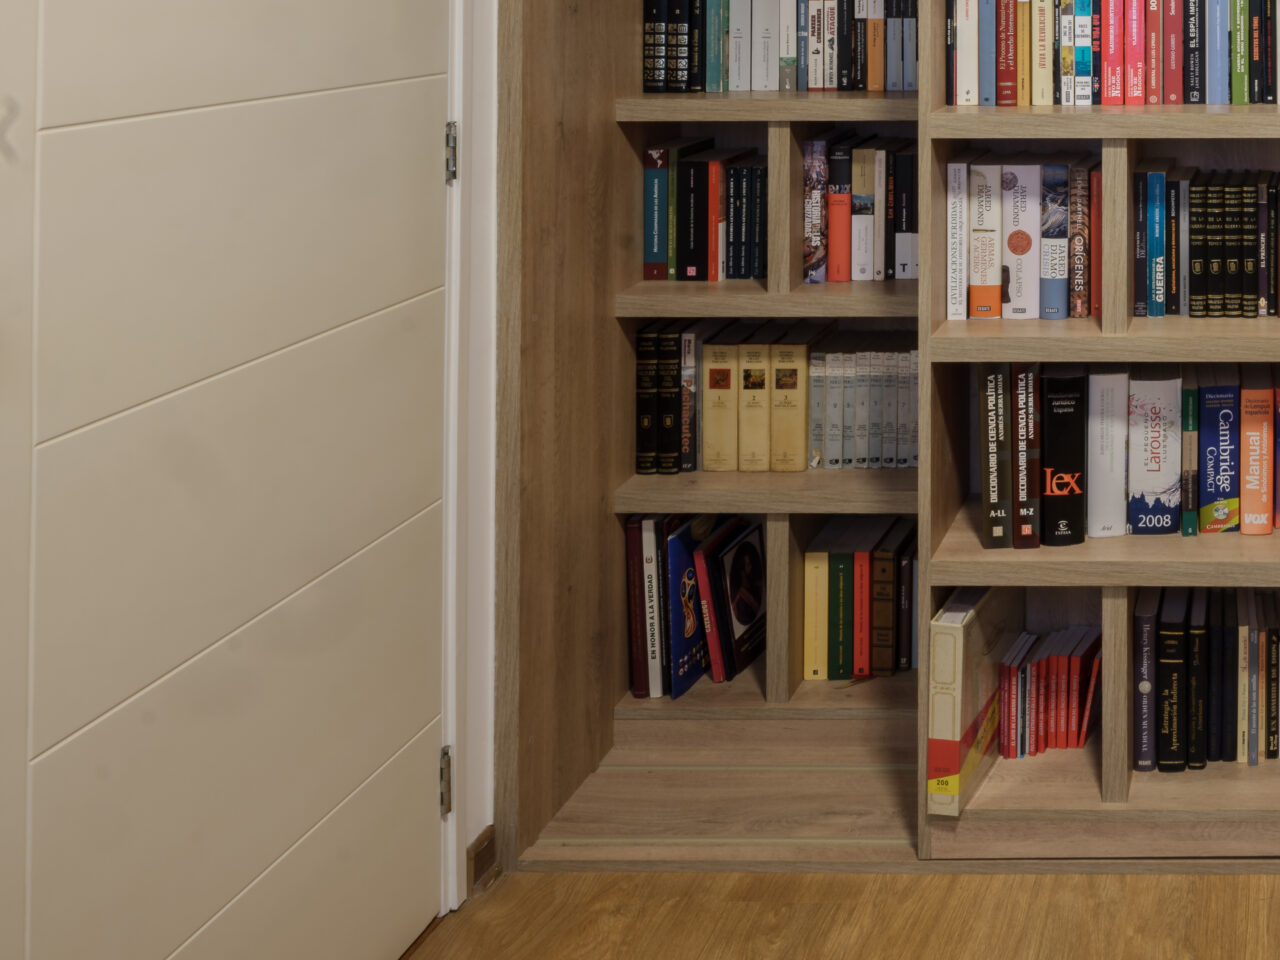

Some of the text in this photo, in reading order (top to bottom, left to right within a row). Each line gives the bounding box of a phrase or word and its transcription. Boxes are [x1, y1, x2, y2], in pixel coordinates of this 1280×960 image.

[1189, 39, 1195, 48] EL
[804, 199, 812, 238] CRUZADAS
[812, 190, 821, 246] HISTORIA LAS
[1074, 235, 1085, 292] ORÍGENES
[1156, 256, 1164, 302] GUERRA
[987, 375, 998, 503] DICCIONARIO DE CIENCIA POLÍTICA
[1017, 373, 1027, 501] DICCIONARIO DE CIENCIA POLÍTICA
[1147, 406, 1161, 473] Larousse
[1216, 410, 1235, 493] Cambridge
[1043, 468, 1083, 496] Lex
[1206, 447, 1217, 494] COMPACT
[1246, 431, 1260, 490] Manual
[990, 509, 1006, 517] A-LL
[1138, 514, 1171, 528] 2008
[1262, 494, 1268, 503] de
[649, 606, 655, 615] LA
[650, 650, 657, 660] EN
[1142, 624, 1150, 680] Henry Kissinger
[1271, 666, 1277, 678] DE
